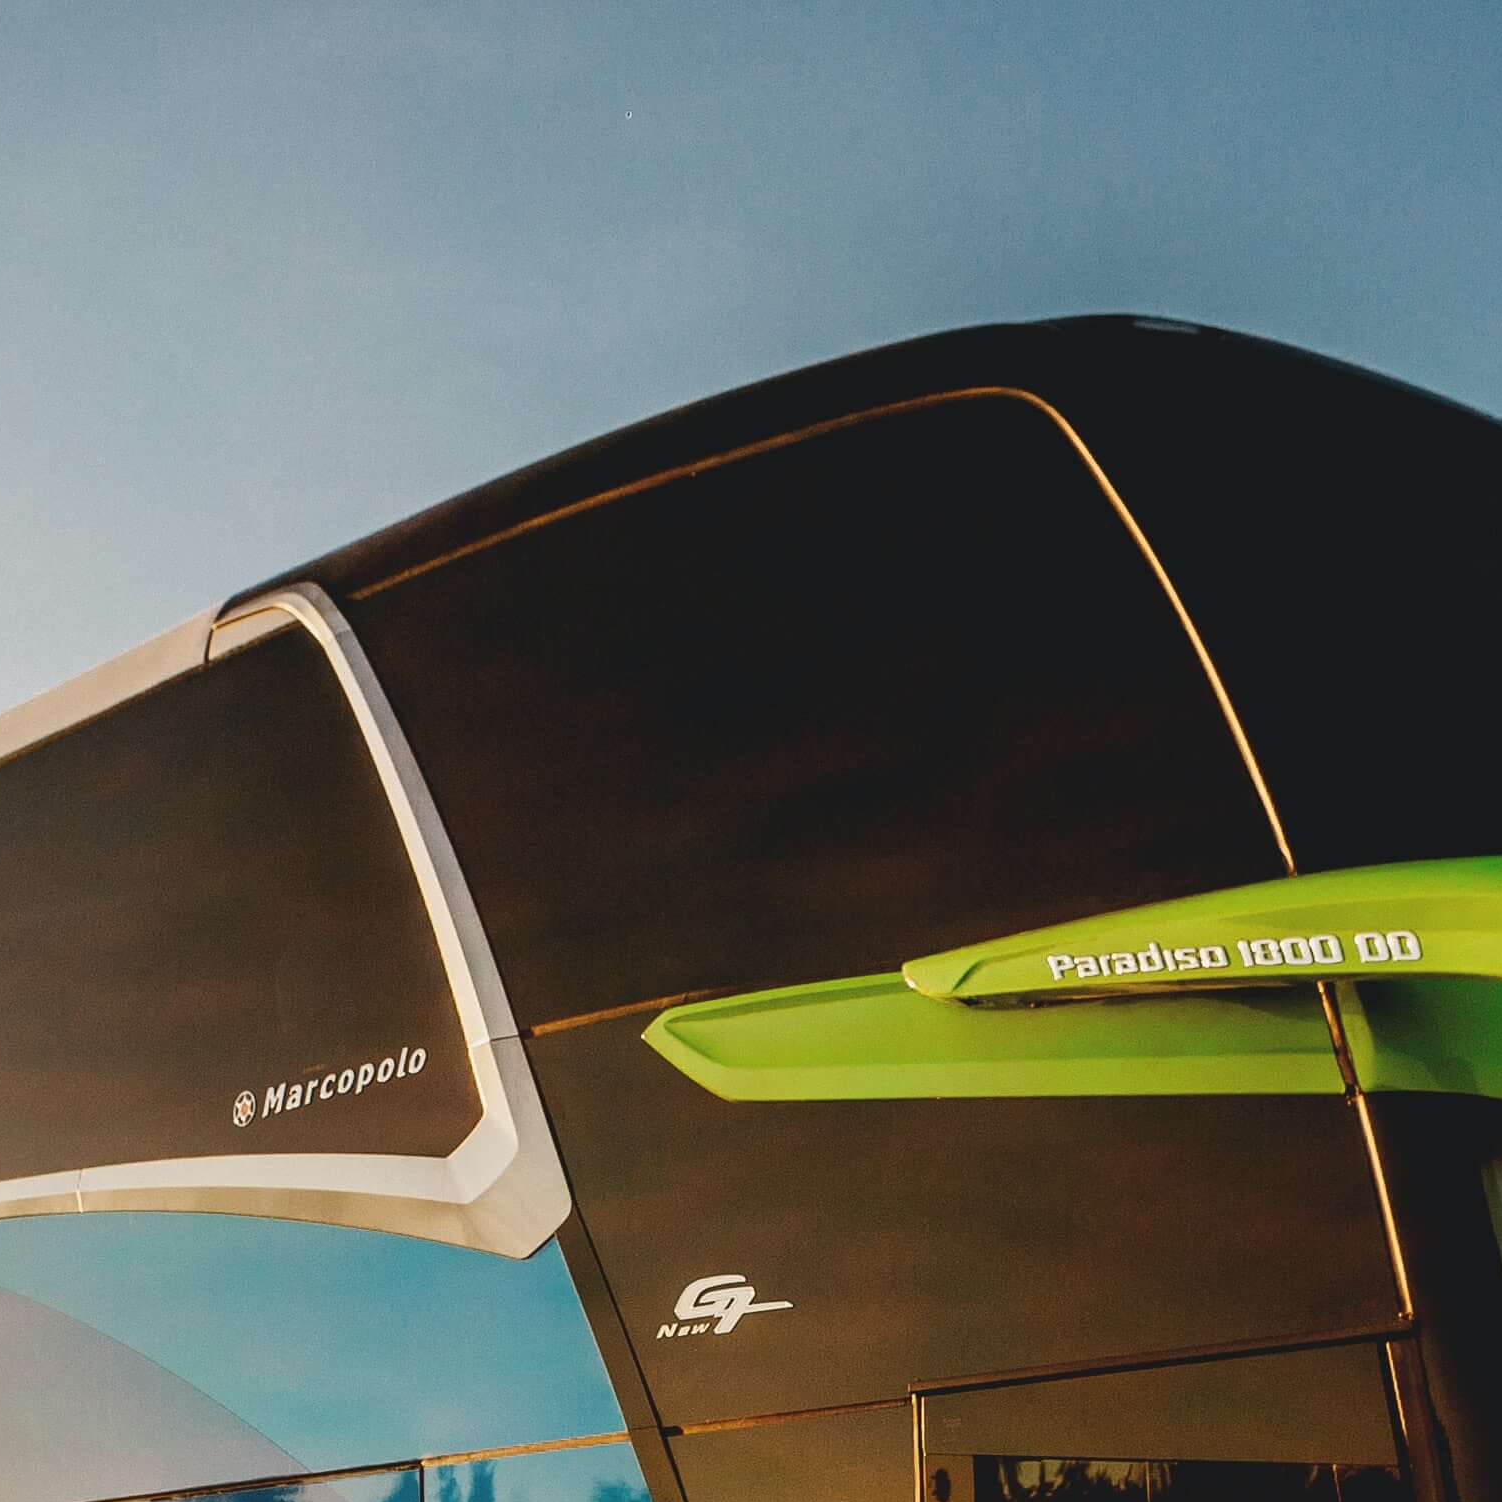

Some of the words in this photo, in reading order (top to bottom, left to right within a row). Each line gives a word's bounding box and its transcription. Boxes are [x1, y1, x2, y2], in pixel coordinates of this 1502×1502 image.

[1046, 941, 1231, 981] Paradiso
[1237, 933, 1345, 968] 1800
[261, 1046, 427, 1118] Marcopolo
[656, 1322, 711, 1340] New
